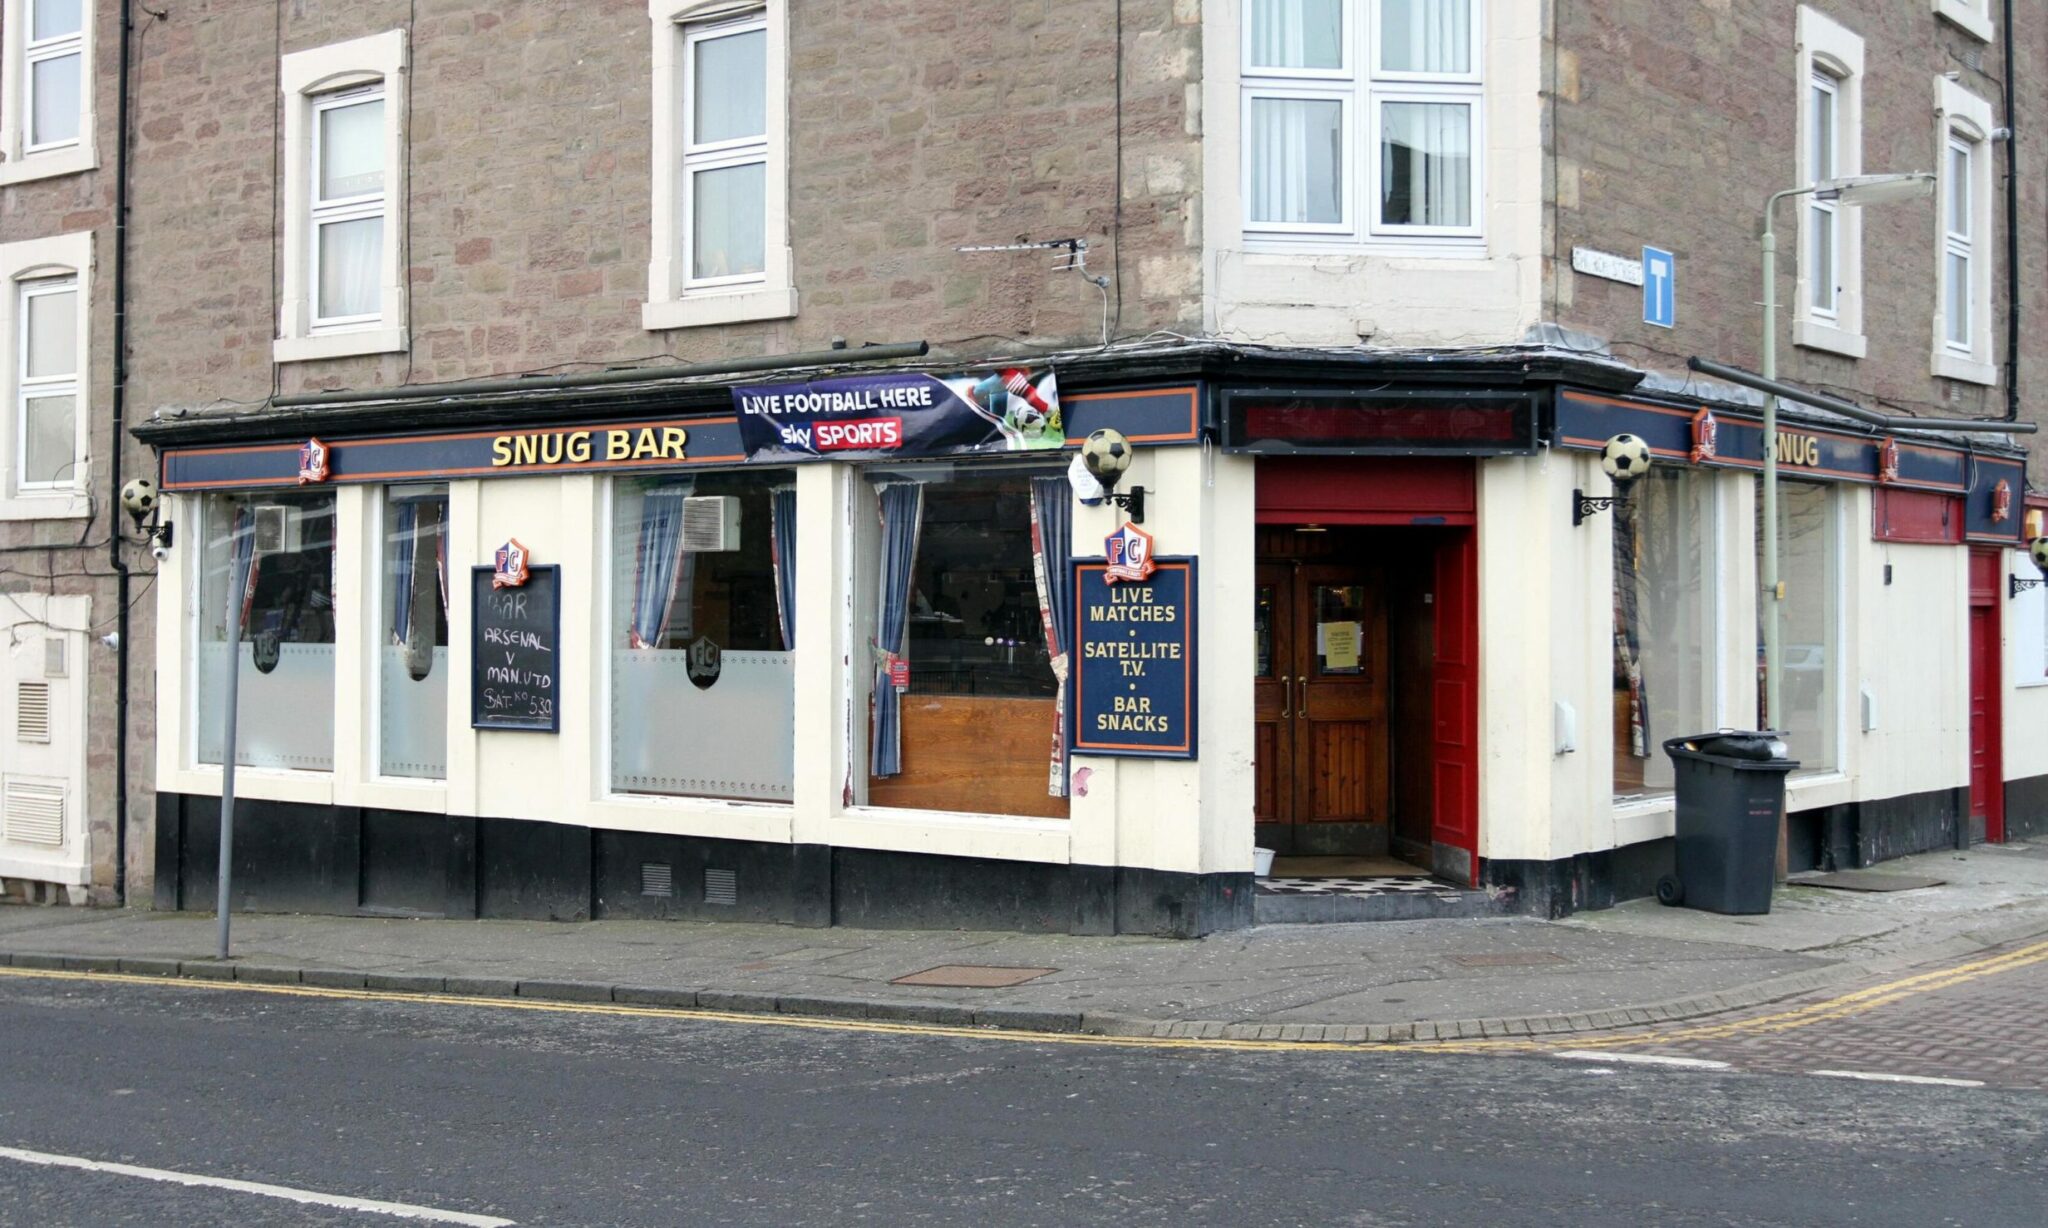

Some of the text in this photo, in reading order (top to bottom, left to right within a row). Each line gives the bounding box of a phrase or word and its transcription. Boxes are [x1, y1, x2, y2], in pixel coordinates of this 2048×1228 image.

[742, 386, 932, 414] LIVE FOOTBALL HERE
[781, 422, 898, 448] sky SPORTS
[492, 427, 687, 466] SNUG BAR
[1776, 432, 1819, 466] NUG
[1109, 538, 1141, 564] FC
[1111, 588, 1153, 604] LIVE
[1090, 606, 1176, 622] MATCHES
[484, 627, 551, 651] ARSENAL
[506, 651, 515, 665] V
[1085, 642, 1181, 659] SATELLITE
[1120, 660, 1146, 676] T.V.
[1114, 696, 1151, 713] BAR
[1097, 714, 1168, 732] SNACKS
